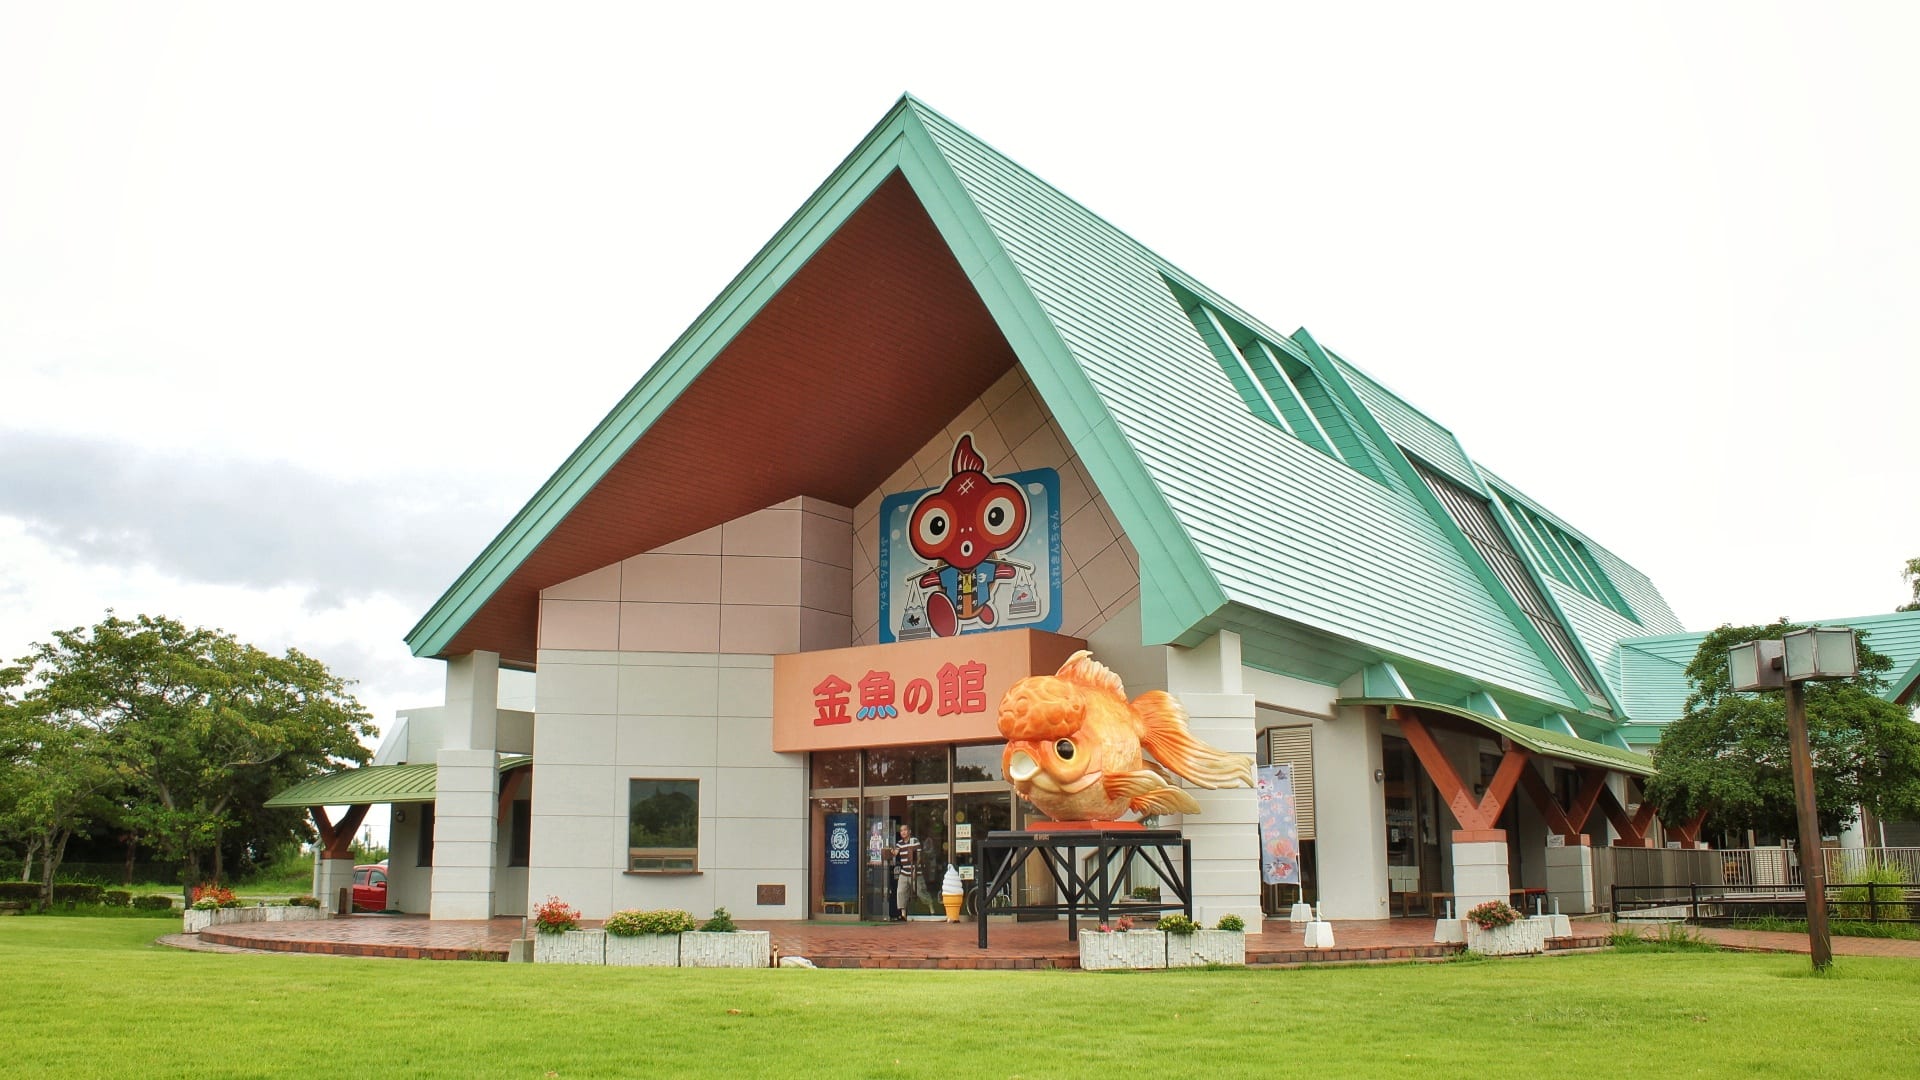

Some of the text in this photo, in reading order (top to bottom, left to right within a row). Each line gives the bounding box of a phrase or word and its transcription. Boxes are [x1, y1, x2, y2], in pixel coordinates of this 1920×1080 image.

[813, 659, 987, 726] 金魚の館
[831, 850, 850, 859] BOSS
